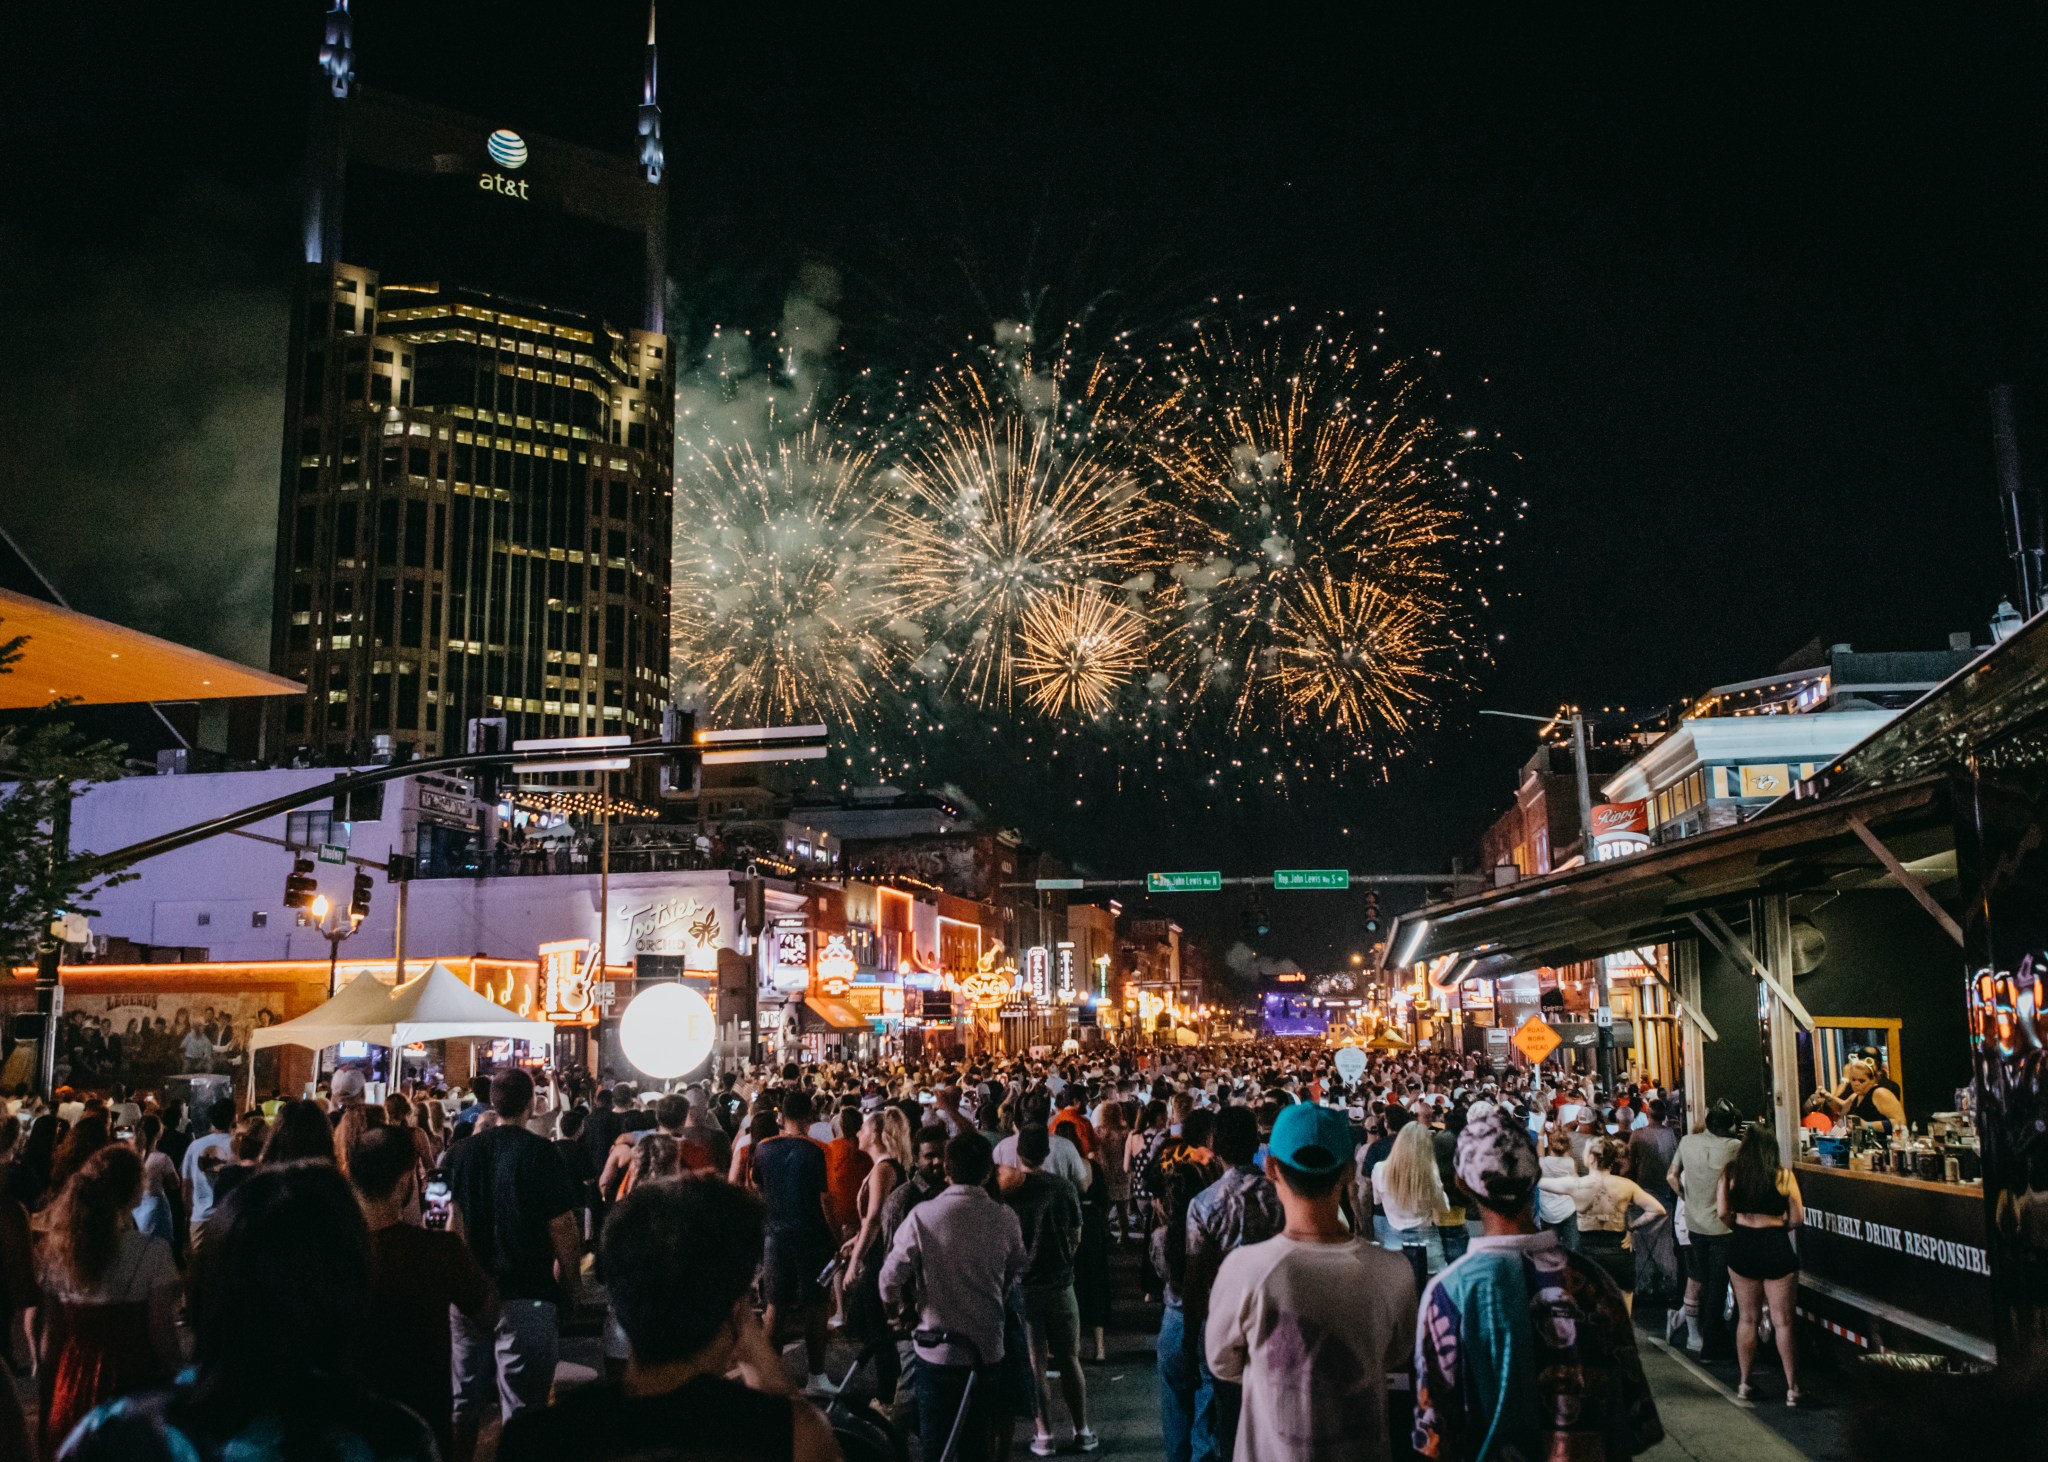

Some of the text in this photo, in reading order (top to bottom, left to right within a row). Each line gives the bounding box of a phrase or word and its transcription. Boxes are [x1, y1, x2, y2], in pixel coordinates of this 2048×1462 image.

[479, 173, 530, 201] at&t
[1593, 801, 1645, 827] Rippy's
[1173, 876, 1185, 886] John
[1186, 876, 1202, 886] Lewis
[1212, 876, 1217, 886] N
[1291, 874, 1304, 884] John
[1305, 873, 1321, 884] Lewis
[1331, 874, 1336, 884] S
[617, 898, 704, 947] Tootsies
[635, 940, 686, 952] ORCHID
[1803, 1206, 1823, 1230] LIVE
[1825, 1212, 1864, 1241] FREELY.
[1865, 1221, 1903, 1251] DRINK
